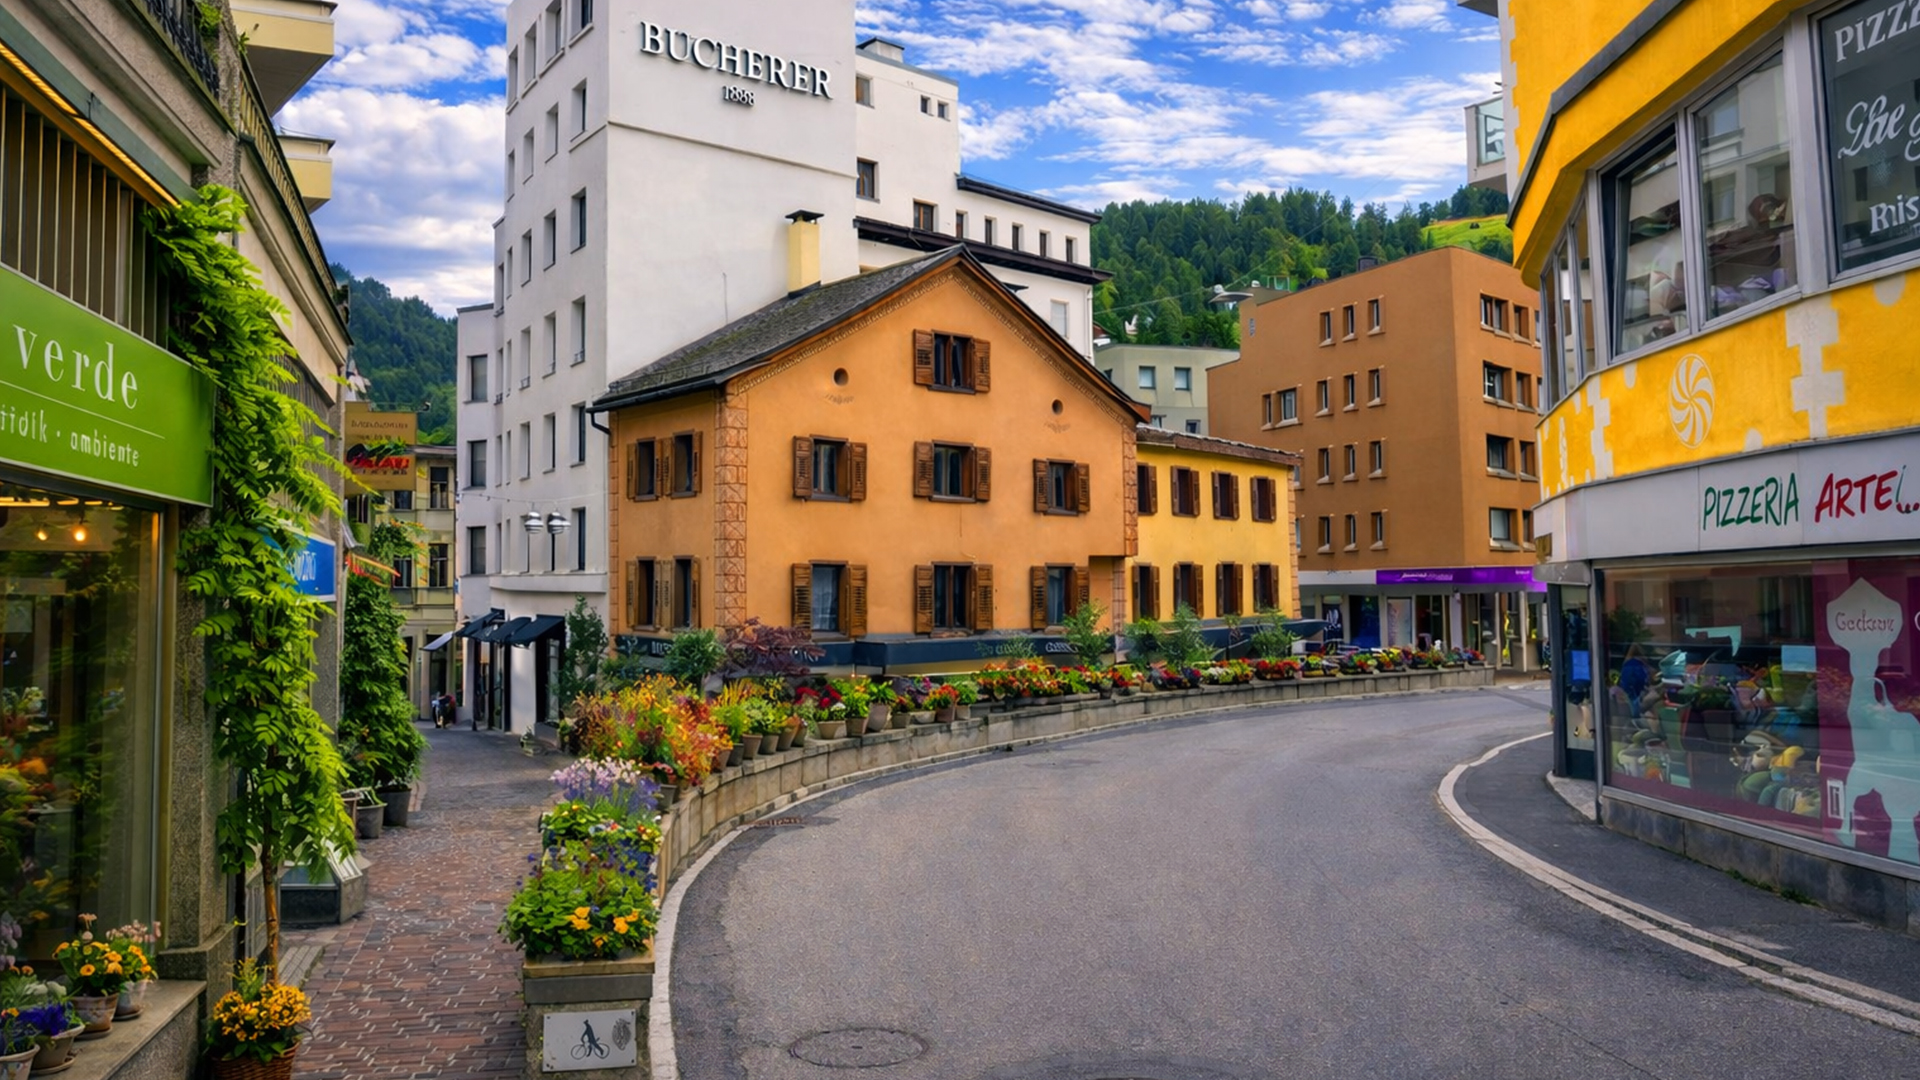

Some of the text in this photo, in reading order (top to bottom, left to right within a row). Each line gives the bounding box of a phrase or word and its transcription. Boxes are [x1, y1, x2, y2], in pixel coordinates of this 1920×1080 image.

[641, 21, 833, 100] BUCHERER
[722, 85, 755, 106] 1888
[12, 324, 138, 409] verde
[70, 429, 139, 467] ambiente
[1703, 472, 1799, 530] PIZZERIA
